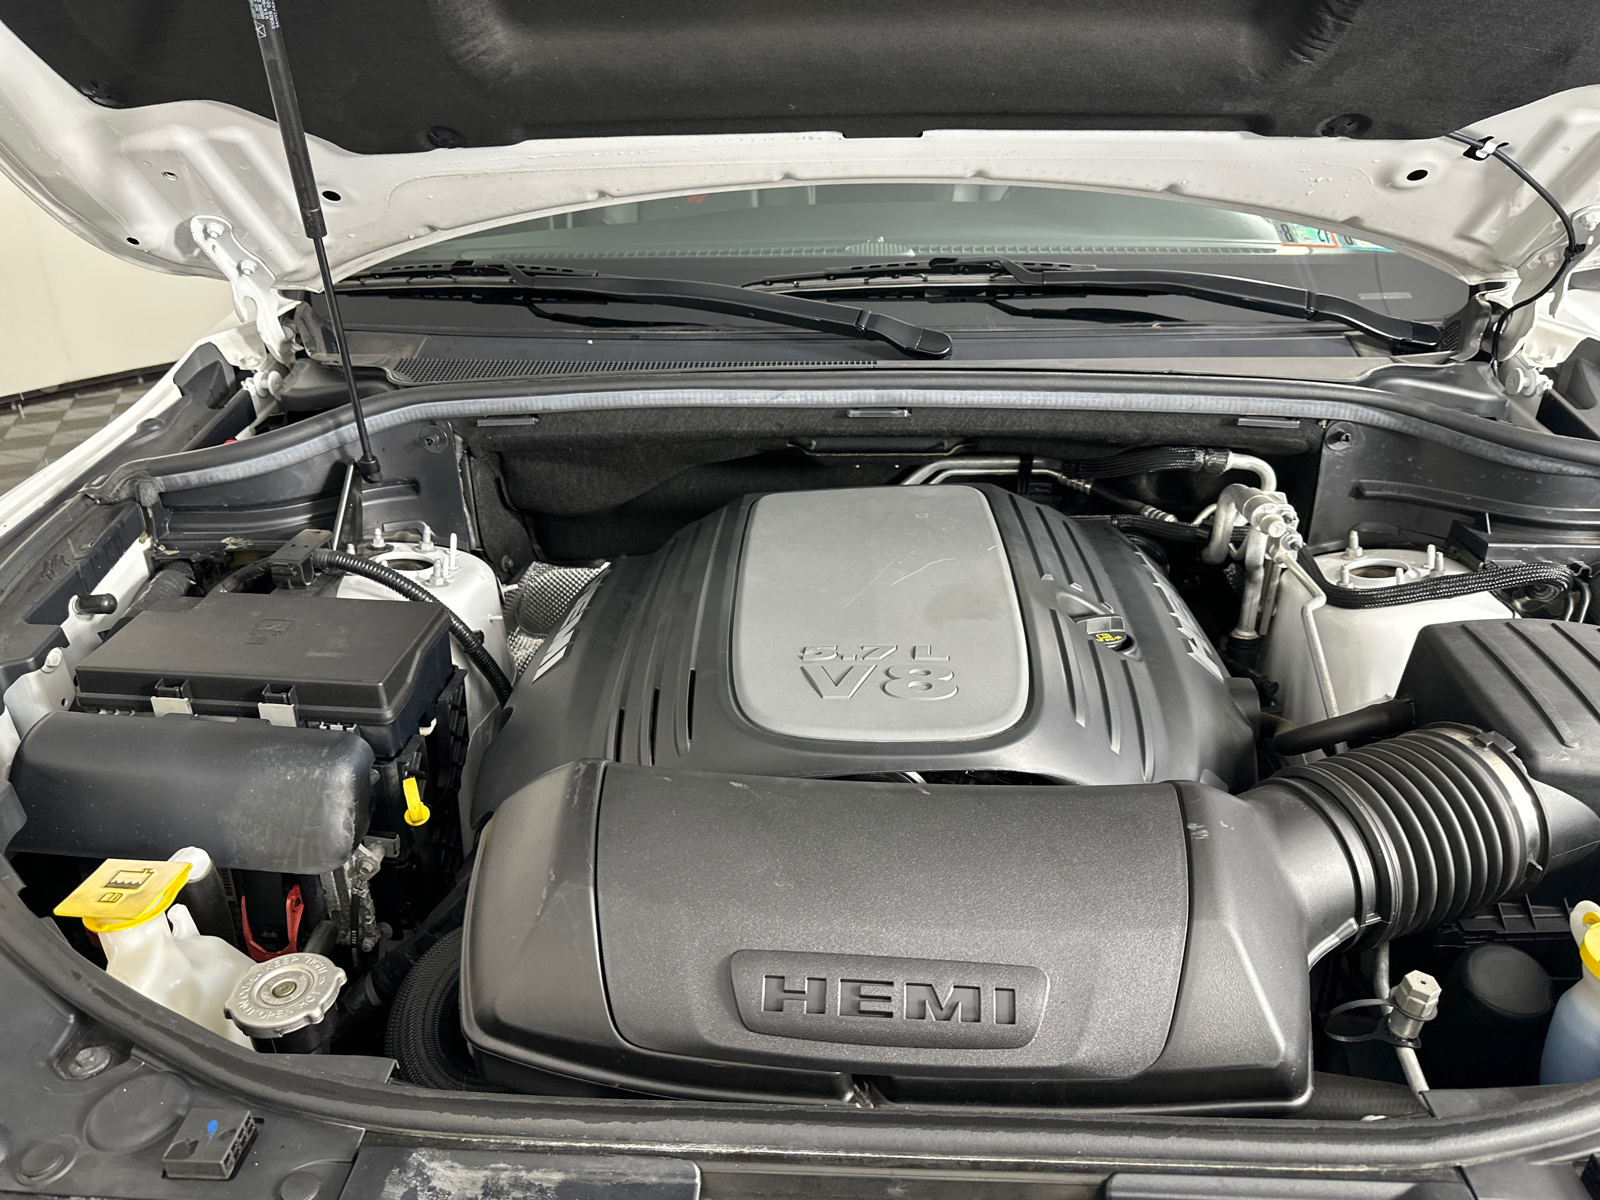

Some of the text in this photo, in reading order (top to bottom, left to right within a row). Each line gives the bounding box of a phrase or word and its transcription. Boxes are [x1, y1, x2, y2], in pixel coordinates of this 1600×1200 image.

[800, 664, 959, 701] V8
[264, 956, 299, 972] KEEP
[762, 975, 1016, 1025] HEMI
[258, 1008, 294, 1020] OPEN
